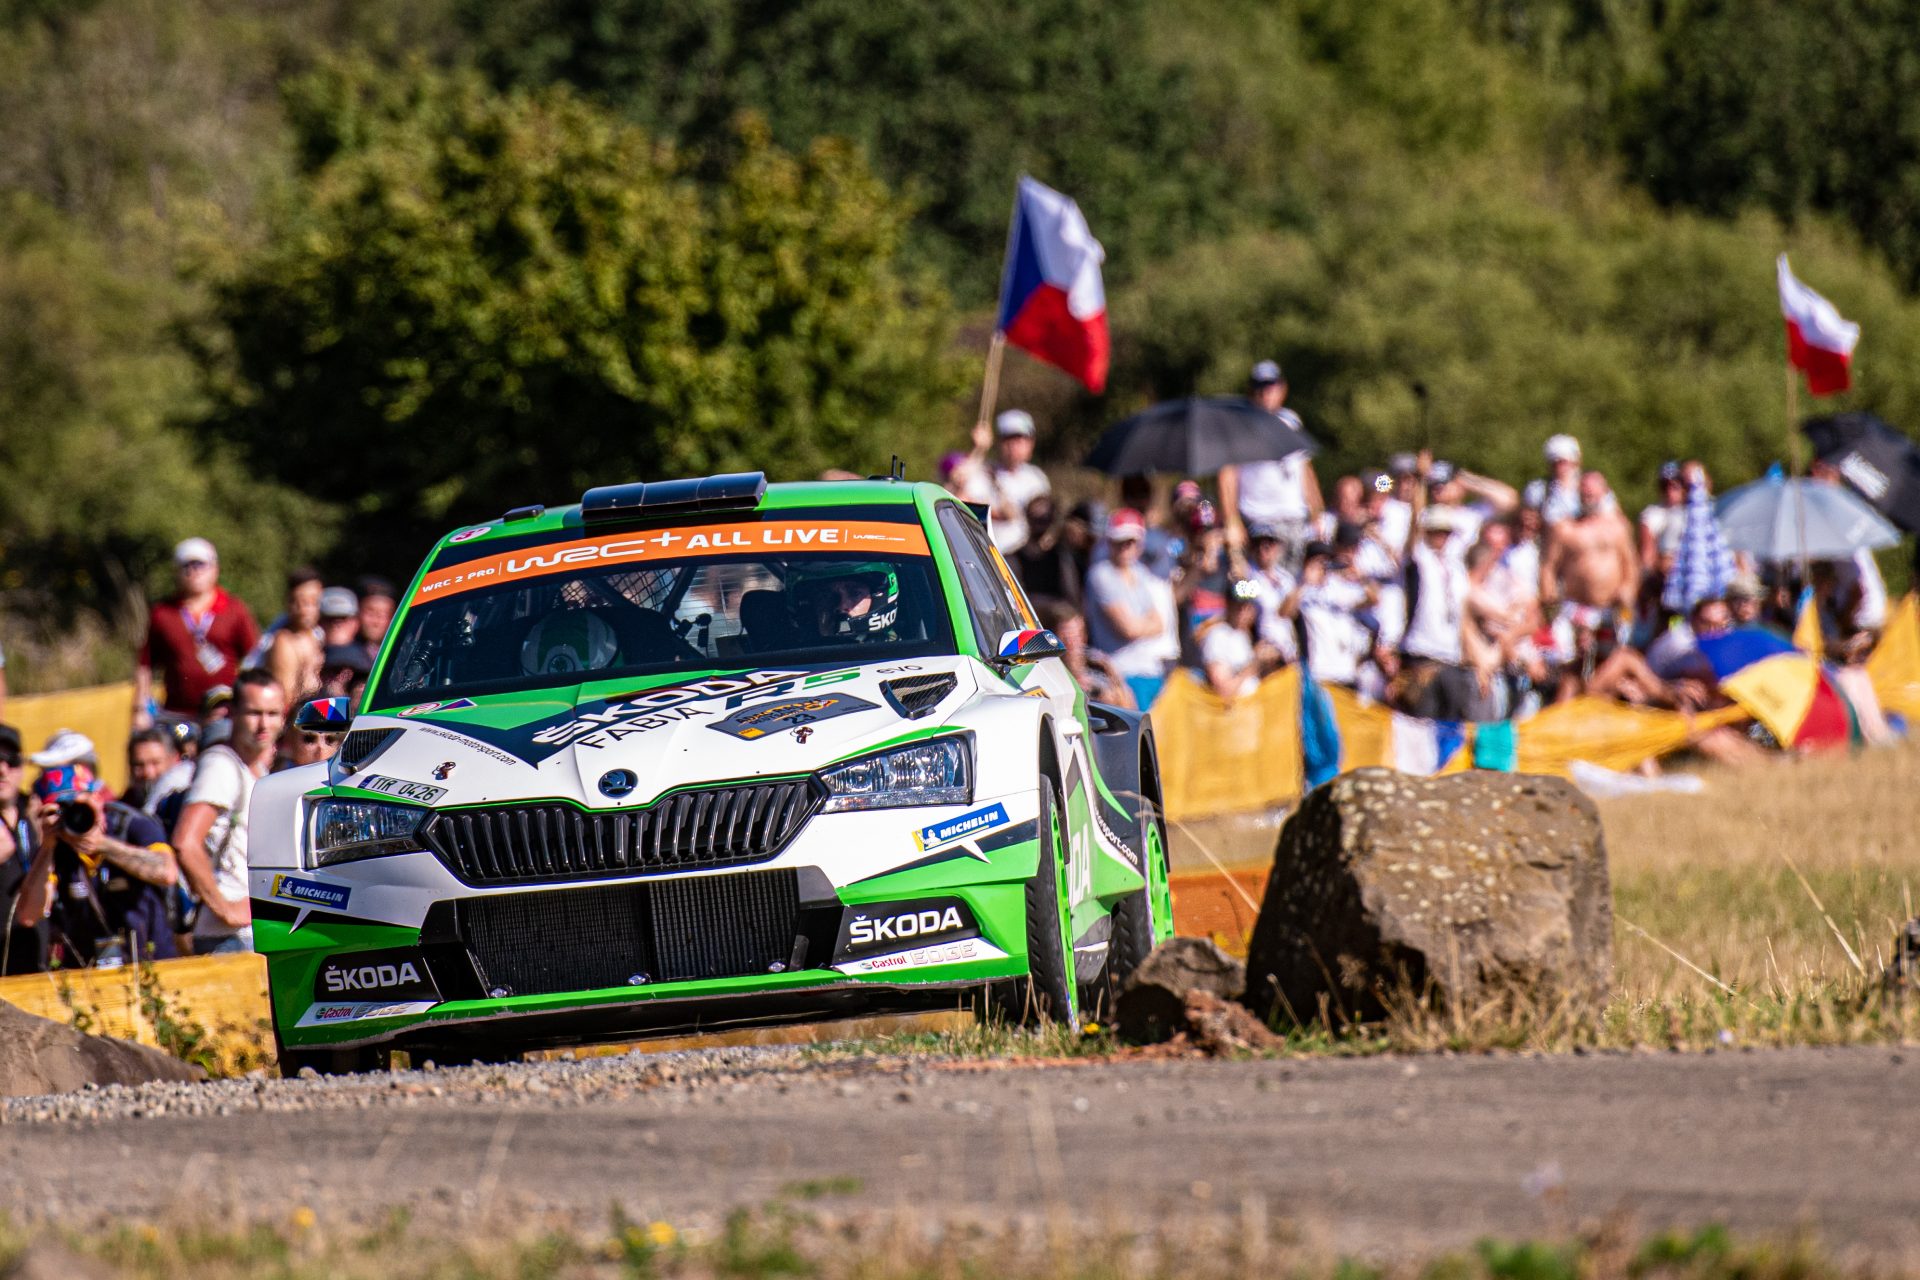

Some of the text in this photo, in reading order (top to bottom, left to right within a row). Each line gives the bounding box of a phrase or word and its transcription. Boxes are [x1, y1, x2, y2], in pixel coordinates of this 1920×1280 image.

[422, 579, 452, 593] WRC
[467, 568, 496, 580] PRO
[686, 531, 752, 549] ALL
[763, 528, 839, 544] LIVE
[876, 664, 923, 675] evo
[575, 706, 712, 749] FABIA
[398, 783, 438, 801] 0426
[940, 810, 999, 839] MICHELIN
[294, 885, 344, 903] MICHELIN
[850, 906, 964, 944] ŠKODA
[871, 942, 978, 970] Castrol EDGE
[324, 962, 421, 992] ŠKODA
[323, 1006, 353, 1019] Castrol
